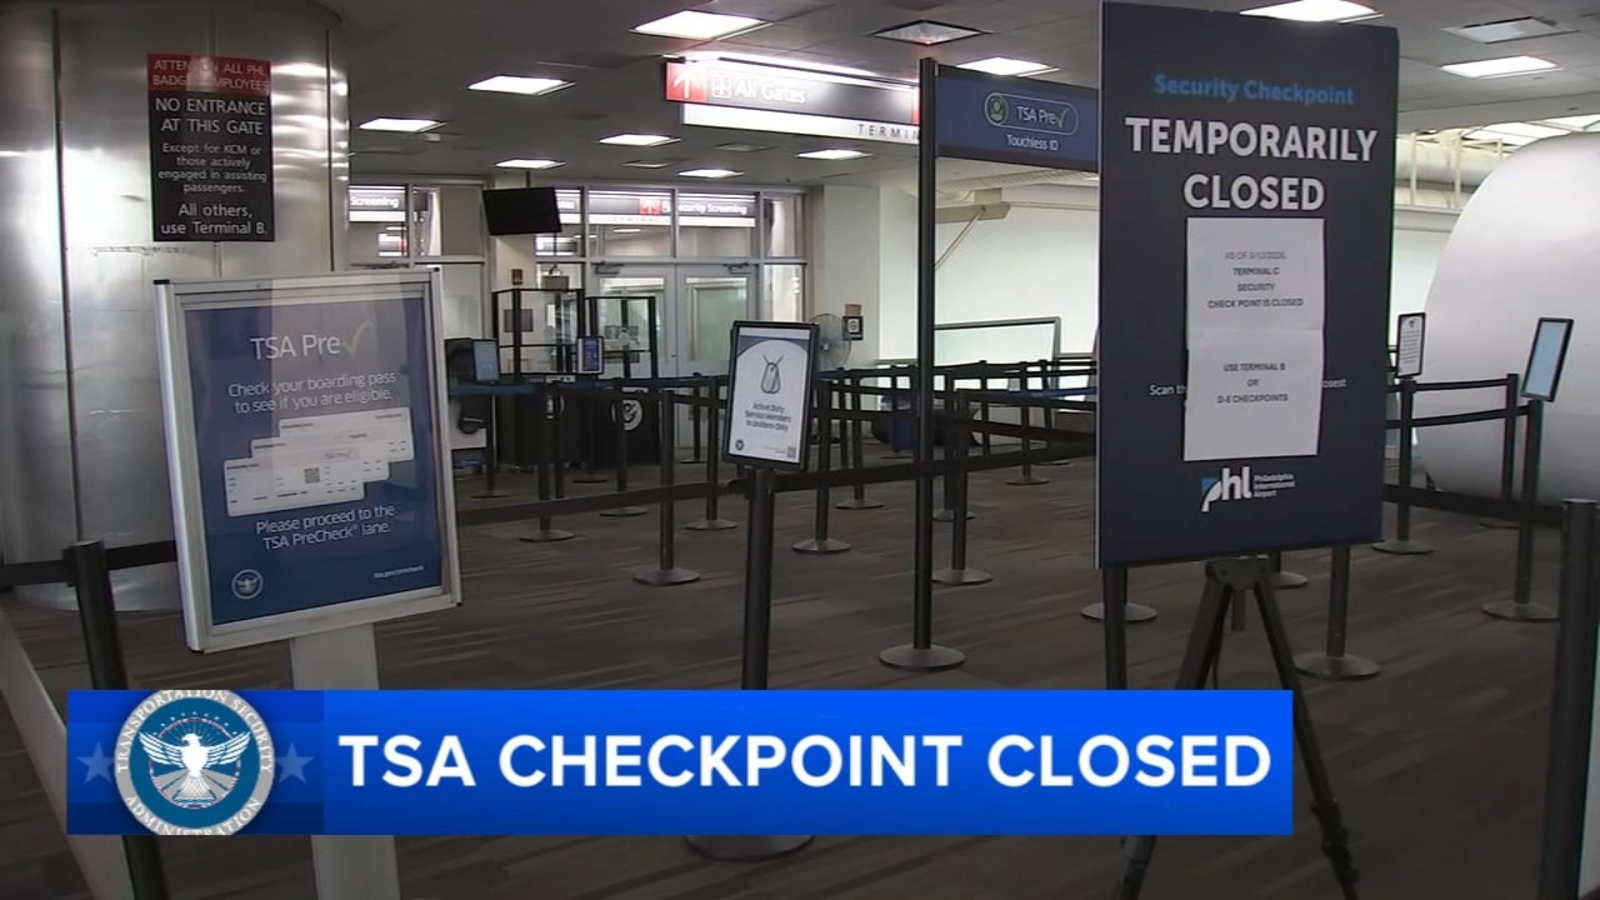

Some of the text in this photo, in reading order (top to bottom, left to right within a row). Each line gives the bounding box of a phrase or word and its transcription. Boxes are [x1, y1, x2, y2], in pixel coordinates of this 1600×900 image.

[223, 62, 242, 75] ALL
[246, 64, 267, 77] PHL
[734, 79, 807, 104] All Gates
[1154, 73, 1355, 107] Security Checkpoint
[155, 98, 267, 116] NO ENTRANCE
[1016, 105, 1037, 122] TSA
[160, 118, 264, 136] AT THIS GATE
[1006, 134, 1060, 151] Touchless ID
[1125, 117, 1379, 162] TEMPORARILY
[162, 142, 262, 156] Except for KCM or
[176, 155, 251, 170] those actively
[157, 169, 268, 183] engaged in assisting
[183, 182, 245, 195] passengers.
[1183, 173, 1326, 212] CLOSED
[349, 194, 400, 209] Screening
[178, 202, 253, 219] All others,
[160, 221, 268, 236] use Terminal B.
[1232, 266, 1281, 276] TERMINAL C
[1236, 282, 1276, 292] SECURITY
[1207, 297, 1305, 309] CHECK POINT IS CLOSED
[249, 333, 342, 361] TSA Pre
[1223, 362, 1238, 372] USE
[1239, 361, 1279, 371] TERMINAL
[228, 371, 397, 398] Check your boarding pass
[1149, 384, 1175, 396] Scan
[1246, 378, 1260, 388] OR
[235, 386, 392, 414] to see if you are eligible.
[1232, 392, 1289, 403] CHECKPOINTS
[1200, 465, 1253, 513] phl
[255, 504, 396, 535] Please proceed to the
[262, 535, 291, 551] TSA
[361, 520, 392, 537] lane.
